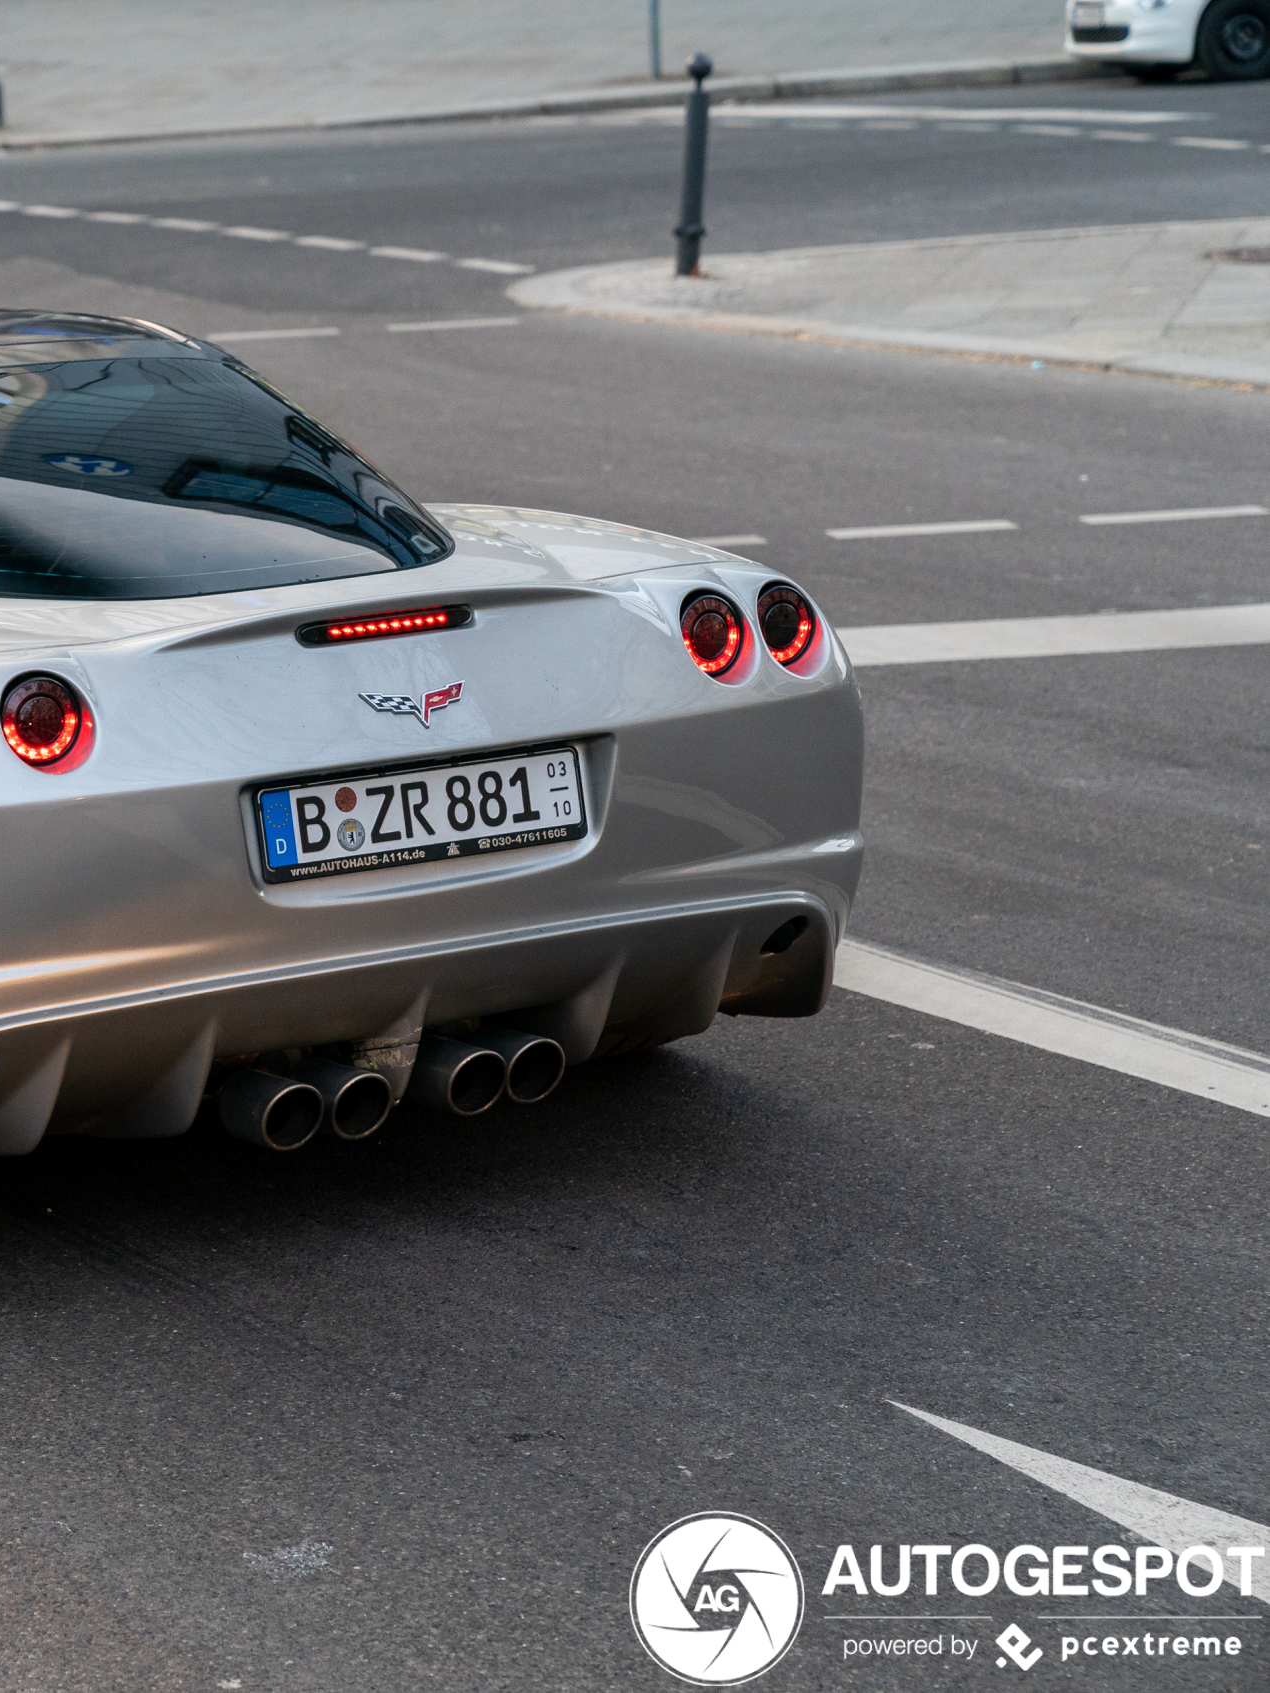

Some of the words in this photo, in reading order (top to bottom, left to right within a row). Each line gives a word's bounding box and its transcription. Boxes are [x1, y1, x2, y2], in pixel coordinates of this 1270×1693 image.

[547, 761, 568, 779] 03
[295, 795, 331, 854] B
[366, 781, 436, 844] ZR
[445, 767, 541, 832] 881
[553, 800, 572, 818] 10
[276, 838, 287, 855] D
[492, 827, 568, 847] 030-47611605
[290, 849, 426, 877] www.AUTOHAUS-A114.de
